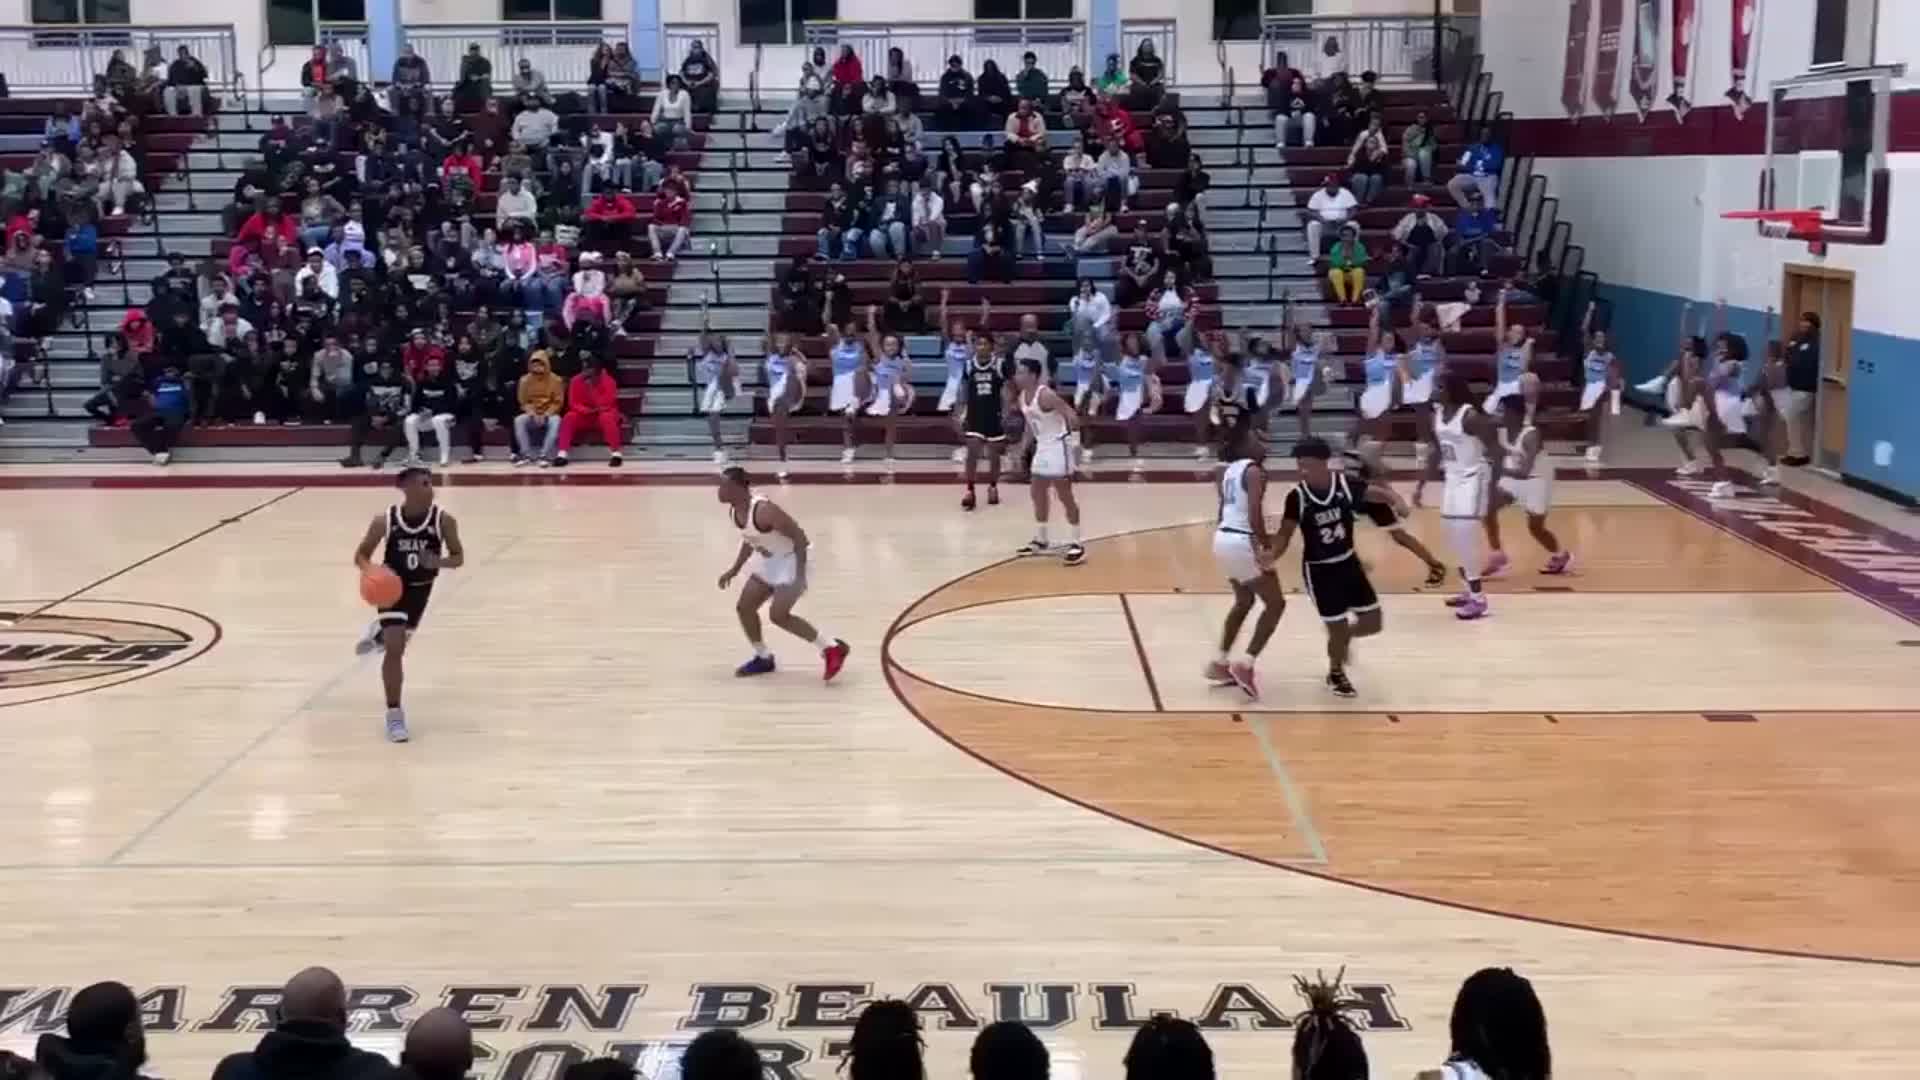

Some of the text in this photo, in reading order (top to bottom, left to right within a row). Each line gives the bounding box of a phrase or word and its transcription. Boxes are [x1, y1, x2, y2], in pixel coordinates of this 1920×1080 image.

[1320, 522, 1346, 545] 24
[407, 552, 418, 570] 0
[677, 982, 1412, 1031] BEAULAH
